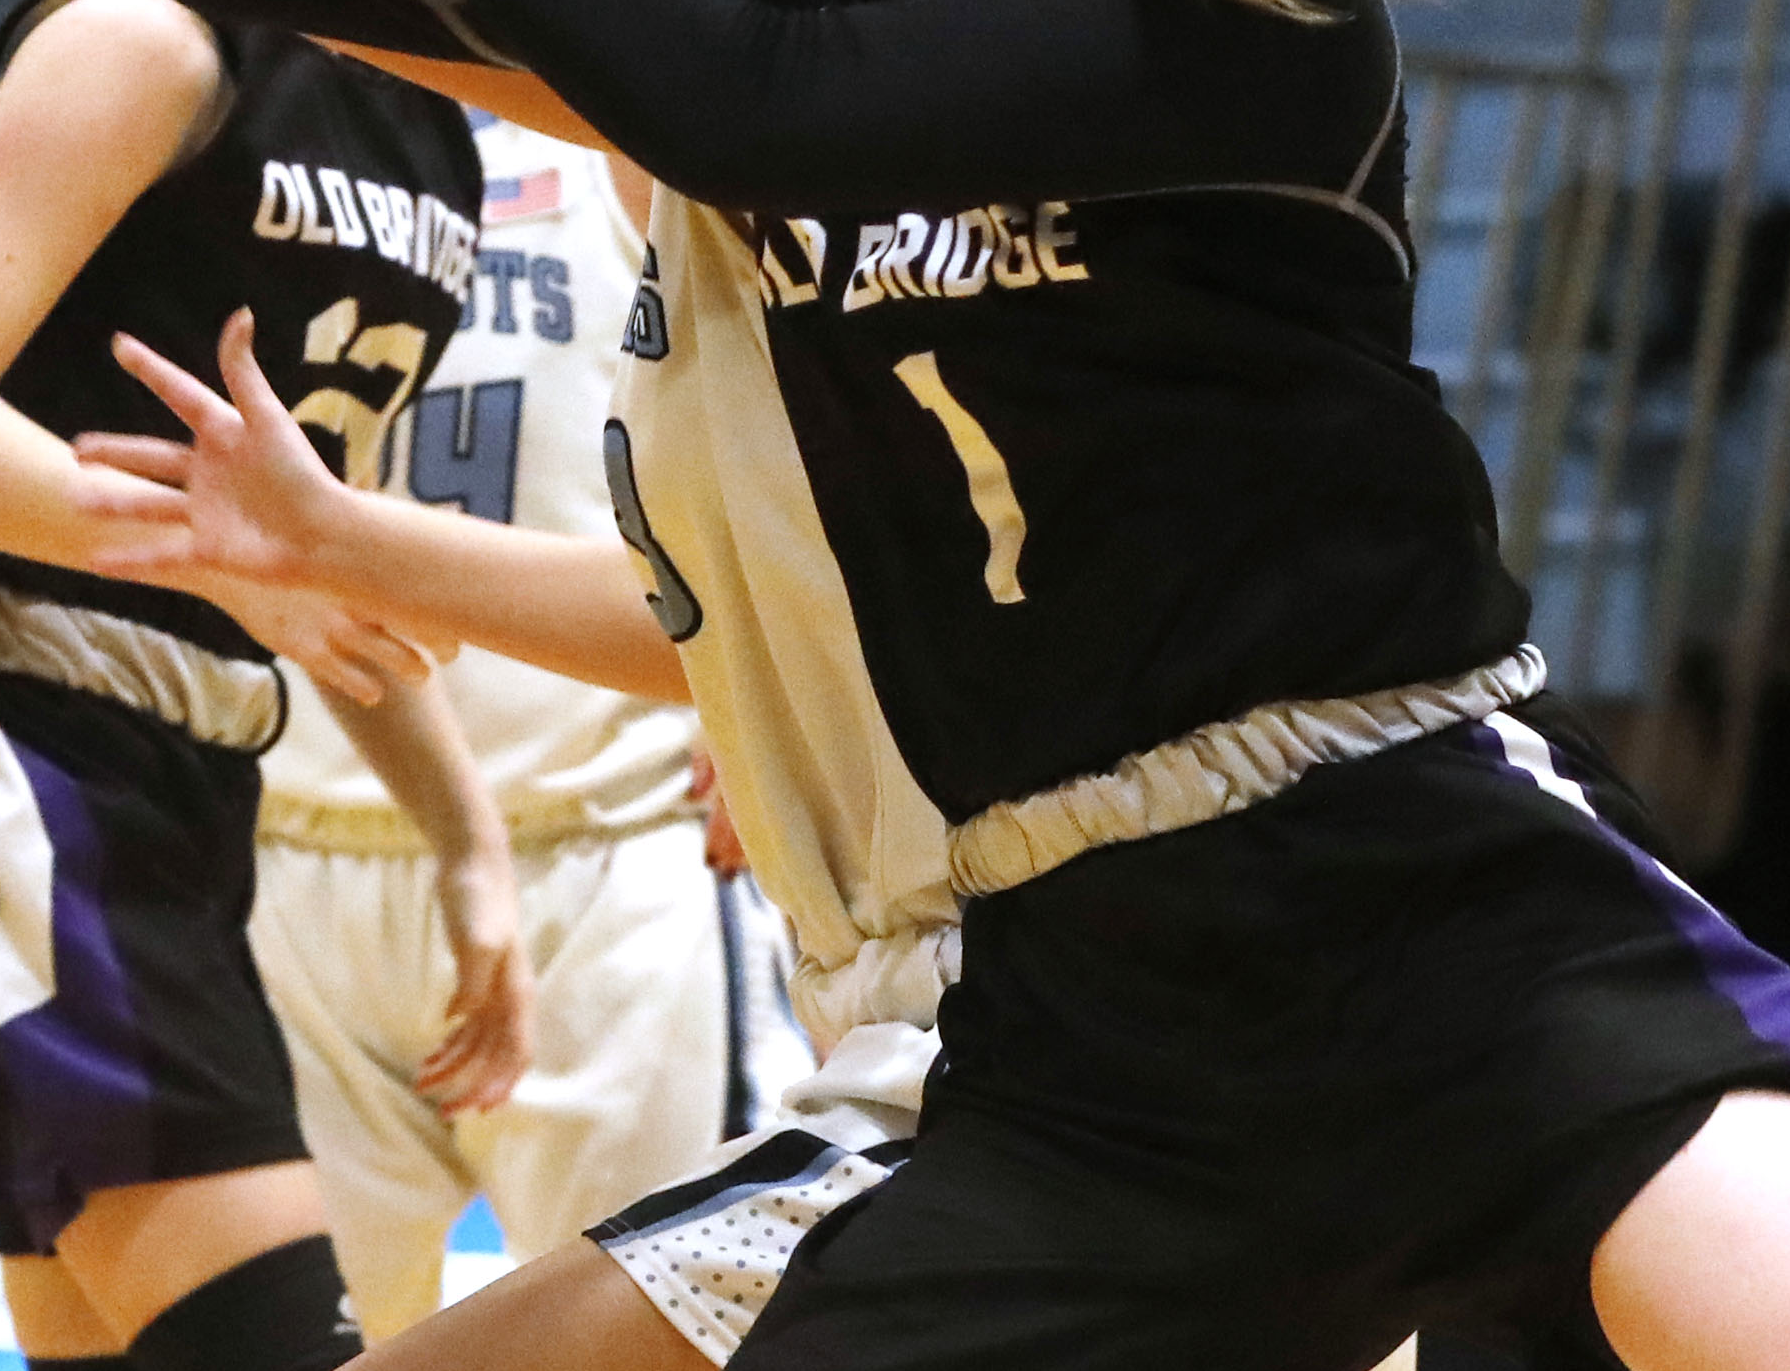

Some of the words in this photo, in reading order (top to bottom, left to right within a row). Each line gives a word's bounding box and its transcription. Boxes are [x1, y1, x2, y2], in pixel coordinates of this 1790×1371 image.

[252, 159, 368, 249] OLD
[744, 211, 828, 310] LD
[842, 200, 1091, 313] BRIDGE
[892, 350, 1028, 605] 1
